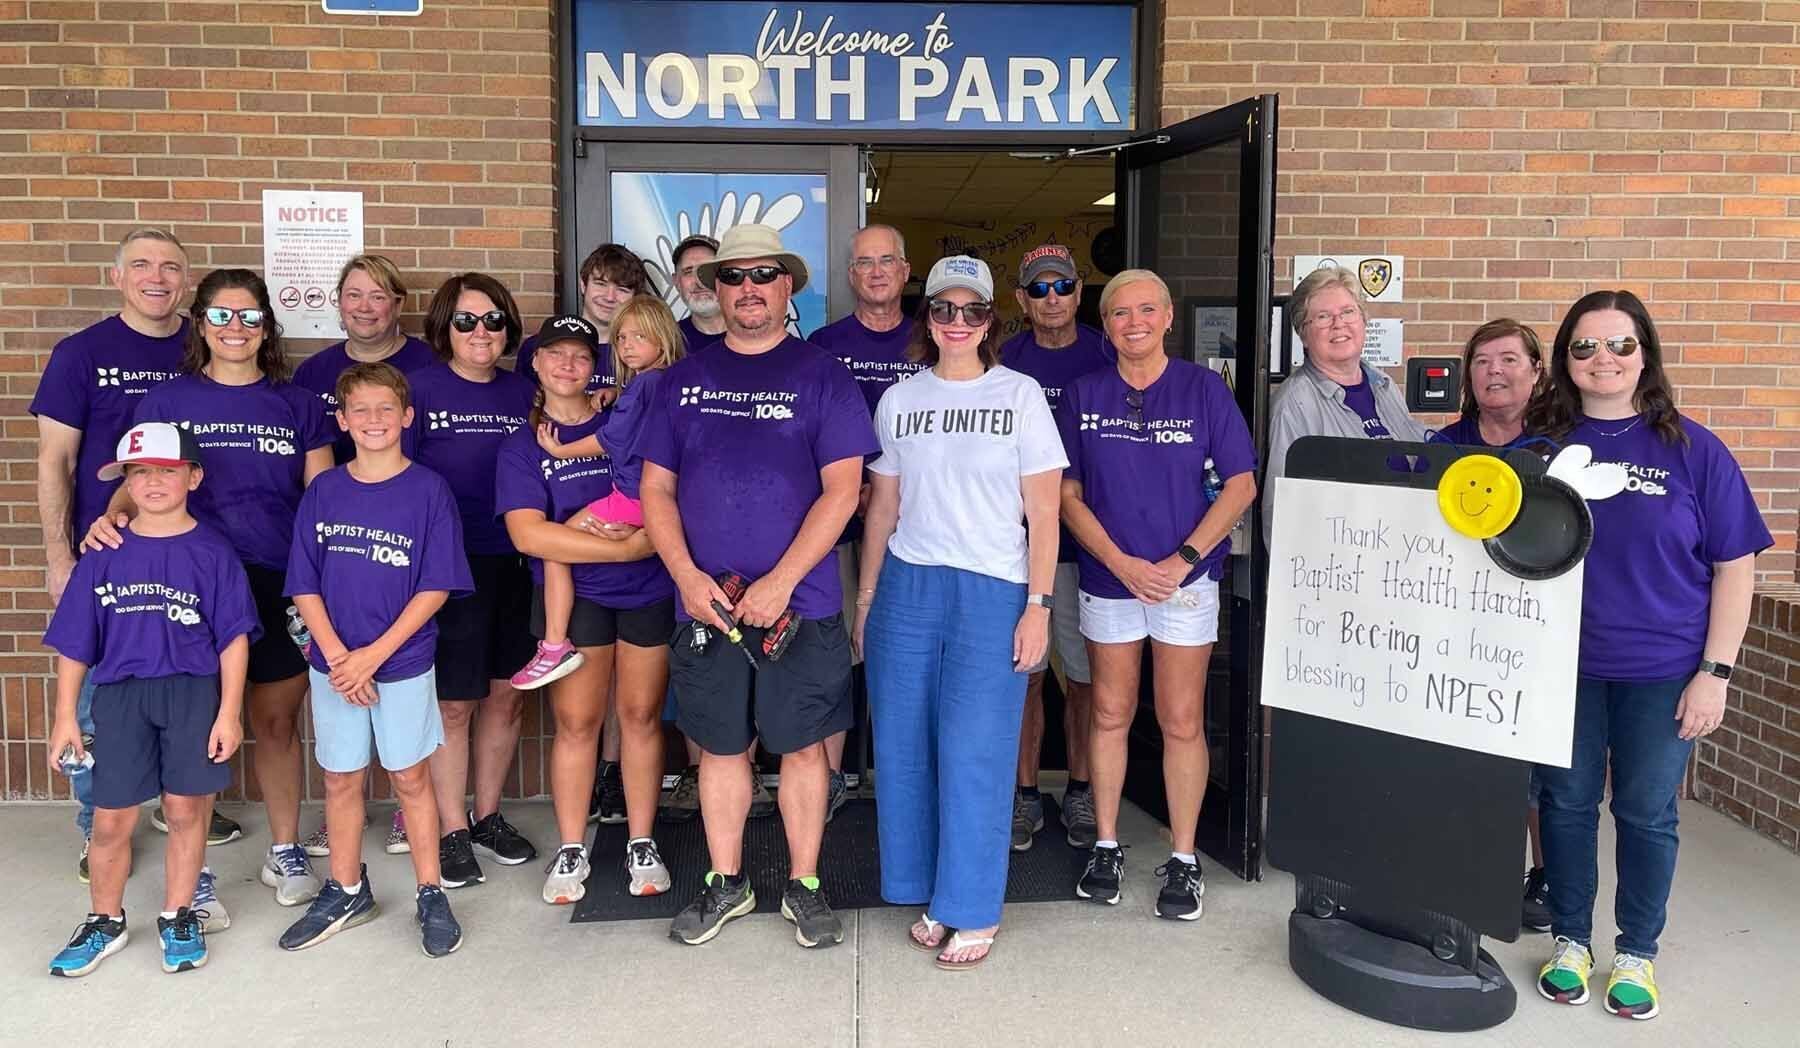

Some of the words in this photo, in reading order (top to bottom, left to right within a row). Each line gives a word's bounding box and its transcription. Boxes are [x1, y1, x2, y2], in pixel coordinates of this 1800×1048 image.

[756, 8, 914, 62] Welcome
[925, 12, 954, 60] to
[585, 52, 866, 121] NORTH
[899, 56, 1121, 123] PARK
[278, 207, 349, 223] NOTICE
[122, 371, 167, 381] BAPTIST
[853, 362, 889, 371] BAPTIST
[702, 390, 750, 402] BAPTIST
[750, 391, 795, 402] HEALTH
[1041, 387, 1063, 397] TIST
[451, 414, 494, 424] BAPTIST
[895, 409, 937, 439] LIVE
[941, 408, 1014, 436] UNITED
[1147, 418, 1191, 430] HEALTH
[193, 423, 246, 435] BAPTIST
[247, 424, 295, 439] HEALTH
[128, 431, 144, 455] E
[366, 528, 413, 549] HEALTH
[1326, 516, 1390, 550] Thank
[1403, 533, 1455, 565] you,
[1291, 553, 1365, 600] Baptist
[1381, 560, 1457, 610] Health
[1469, 568, 1547, 626] Hardin,
[1294, 604, 1326, 637] for
[1340, 611, 1421, 671] Bee-ing
[1436, 638, 1450, 657] a
[1470, 628, 1525, 681] huge
[1286, 646, 1366, 708] blessing
[1384, 664, 1409, 704] to
[1425, 673, 1523, 736] NPES!
